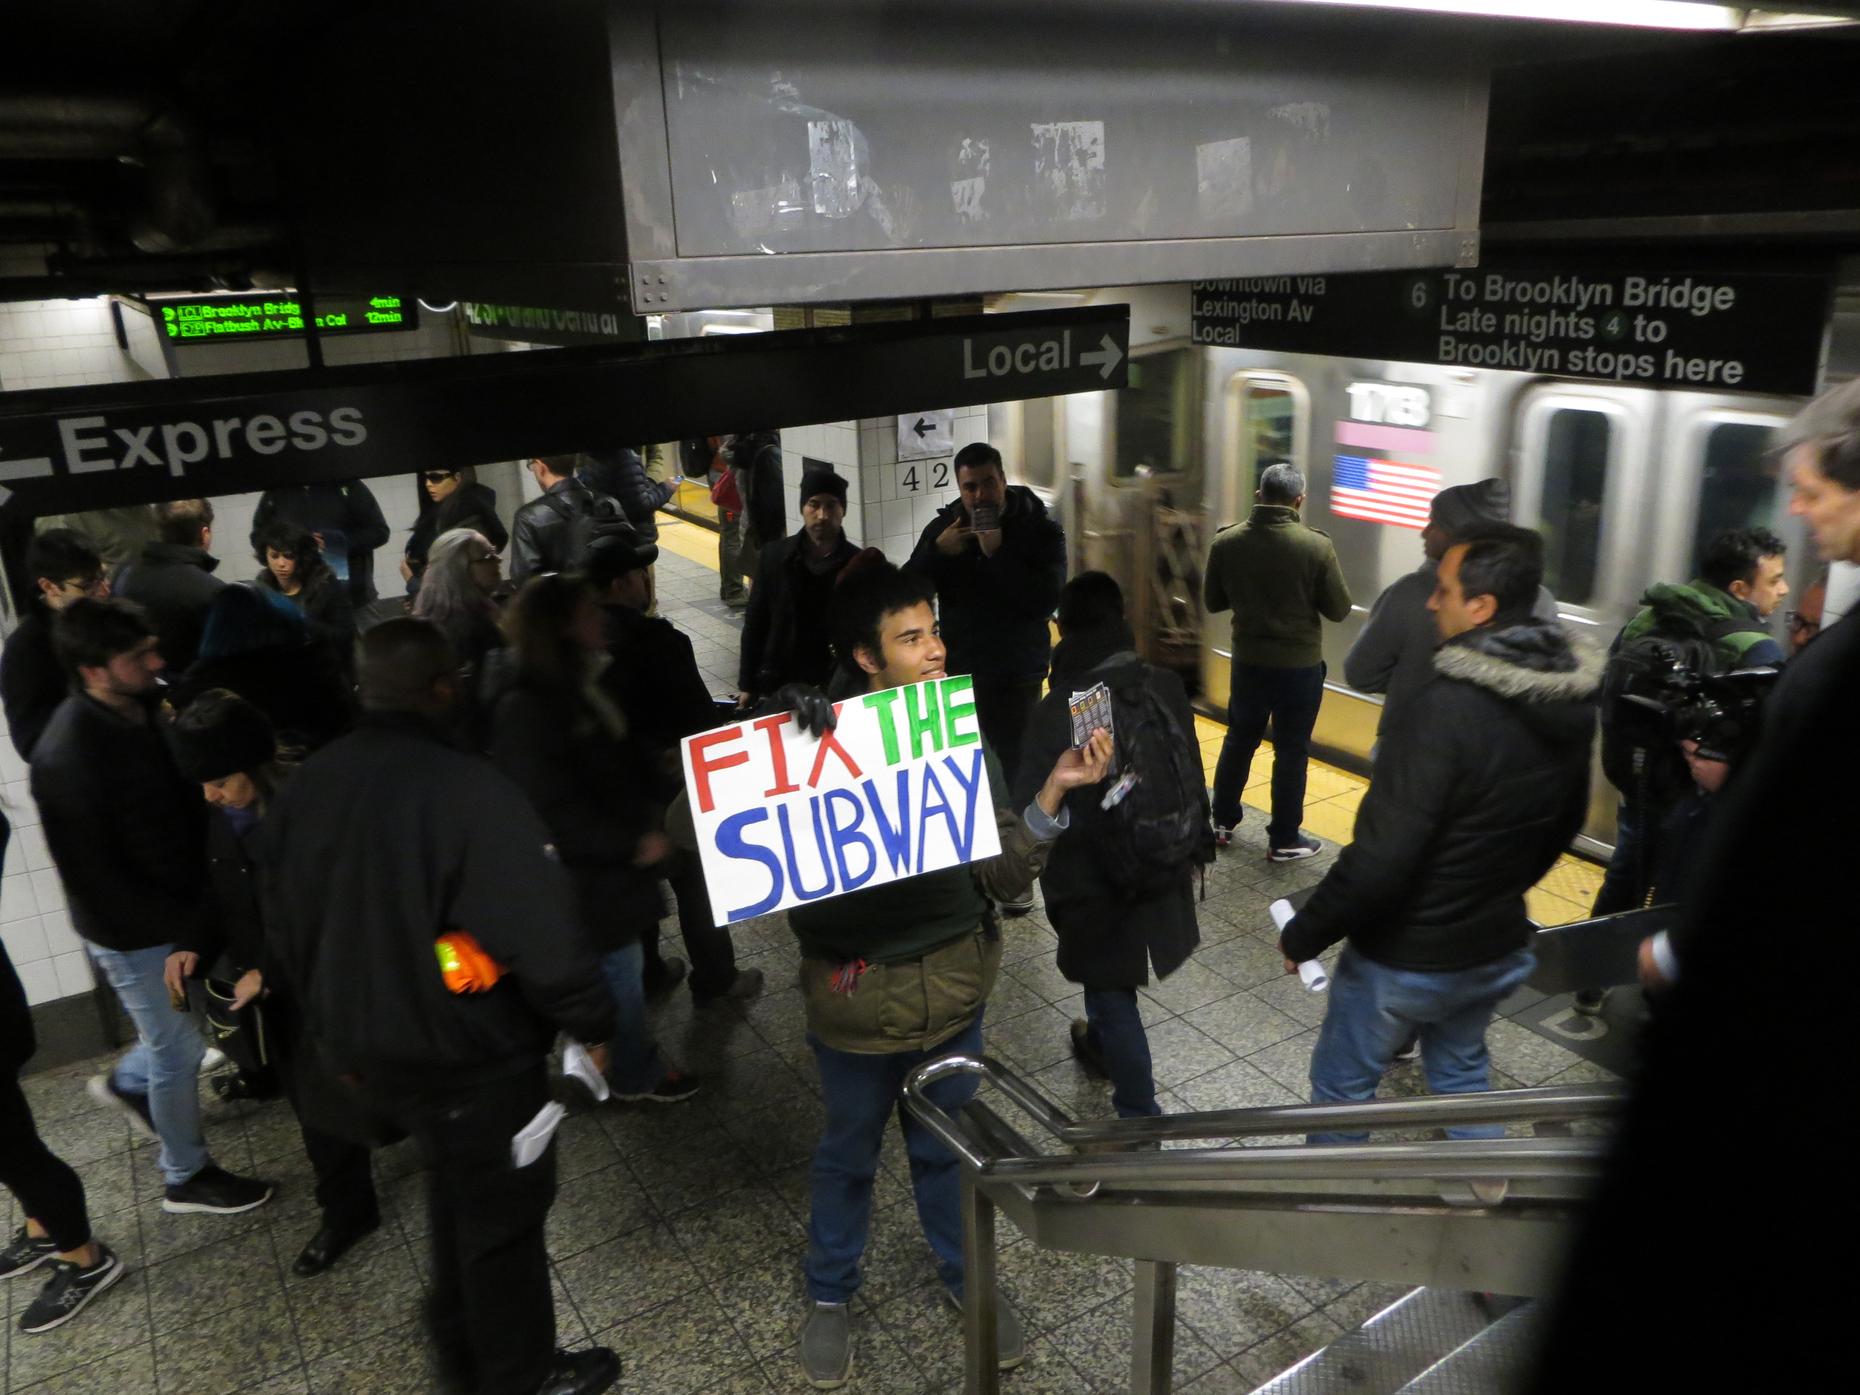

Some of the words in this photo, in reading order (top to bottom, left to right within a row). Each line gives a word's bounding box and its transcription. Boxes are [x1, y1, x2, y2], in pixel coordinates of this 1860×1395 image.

[1297, 276, 1327, 296] via
[1411, 282, 1427, 308] 6
[1443, 274, 1476, 301] To
[1484, 274, 1613, 311] Brooklyn
[1622, 276, 1736, 316] Bridge
[202, 304, 262, 318] Brooklyn
[264, 302, 301, 315] Bridg
[205, 319, 261, 334] Flatbush
[1192, 294, 1282, 324] Lexington
[1286, 299, 1314, 323] Av
[1440, 305, 1498, 333] Late
[1504, 307, 1596, 342] nights
[1607, 315, 1619, 335] 4
[1633, 314, 1668, 343] to
[1192, 320, 1240, 344] Local
[963, 329, 1071, 379] Local
[1438, 336, 1560, 373] Brooklyn
[1567, 345, 1656, 381] stops
[1663, 349, 1744, 385] here
[57, 407, 368, 478] Express
[689, 703, 864, 814] FIX
[862, 675, 980, 767] THE
[714, 748, 985, 923] SUBWAY
